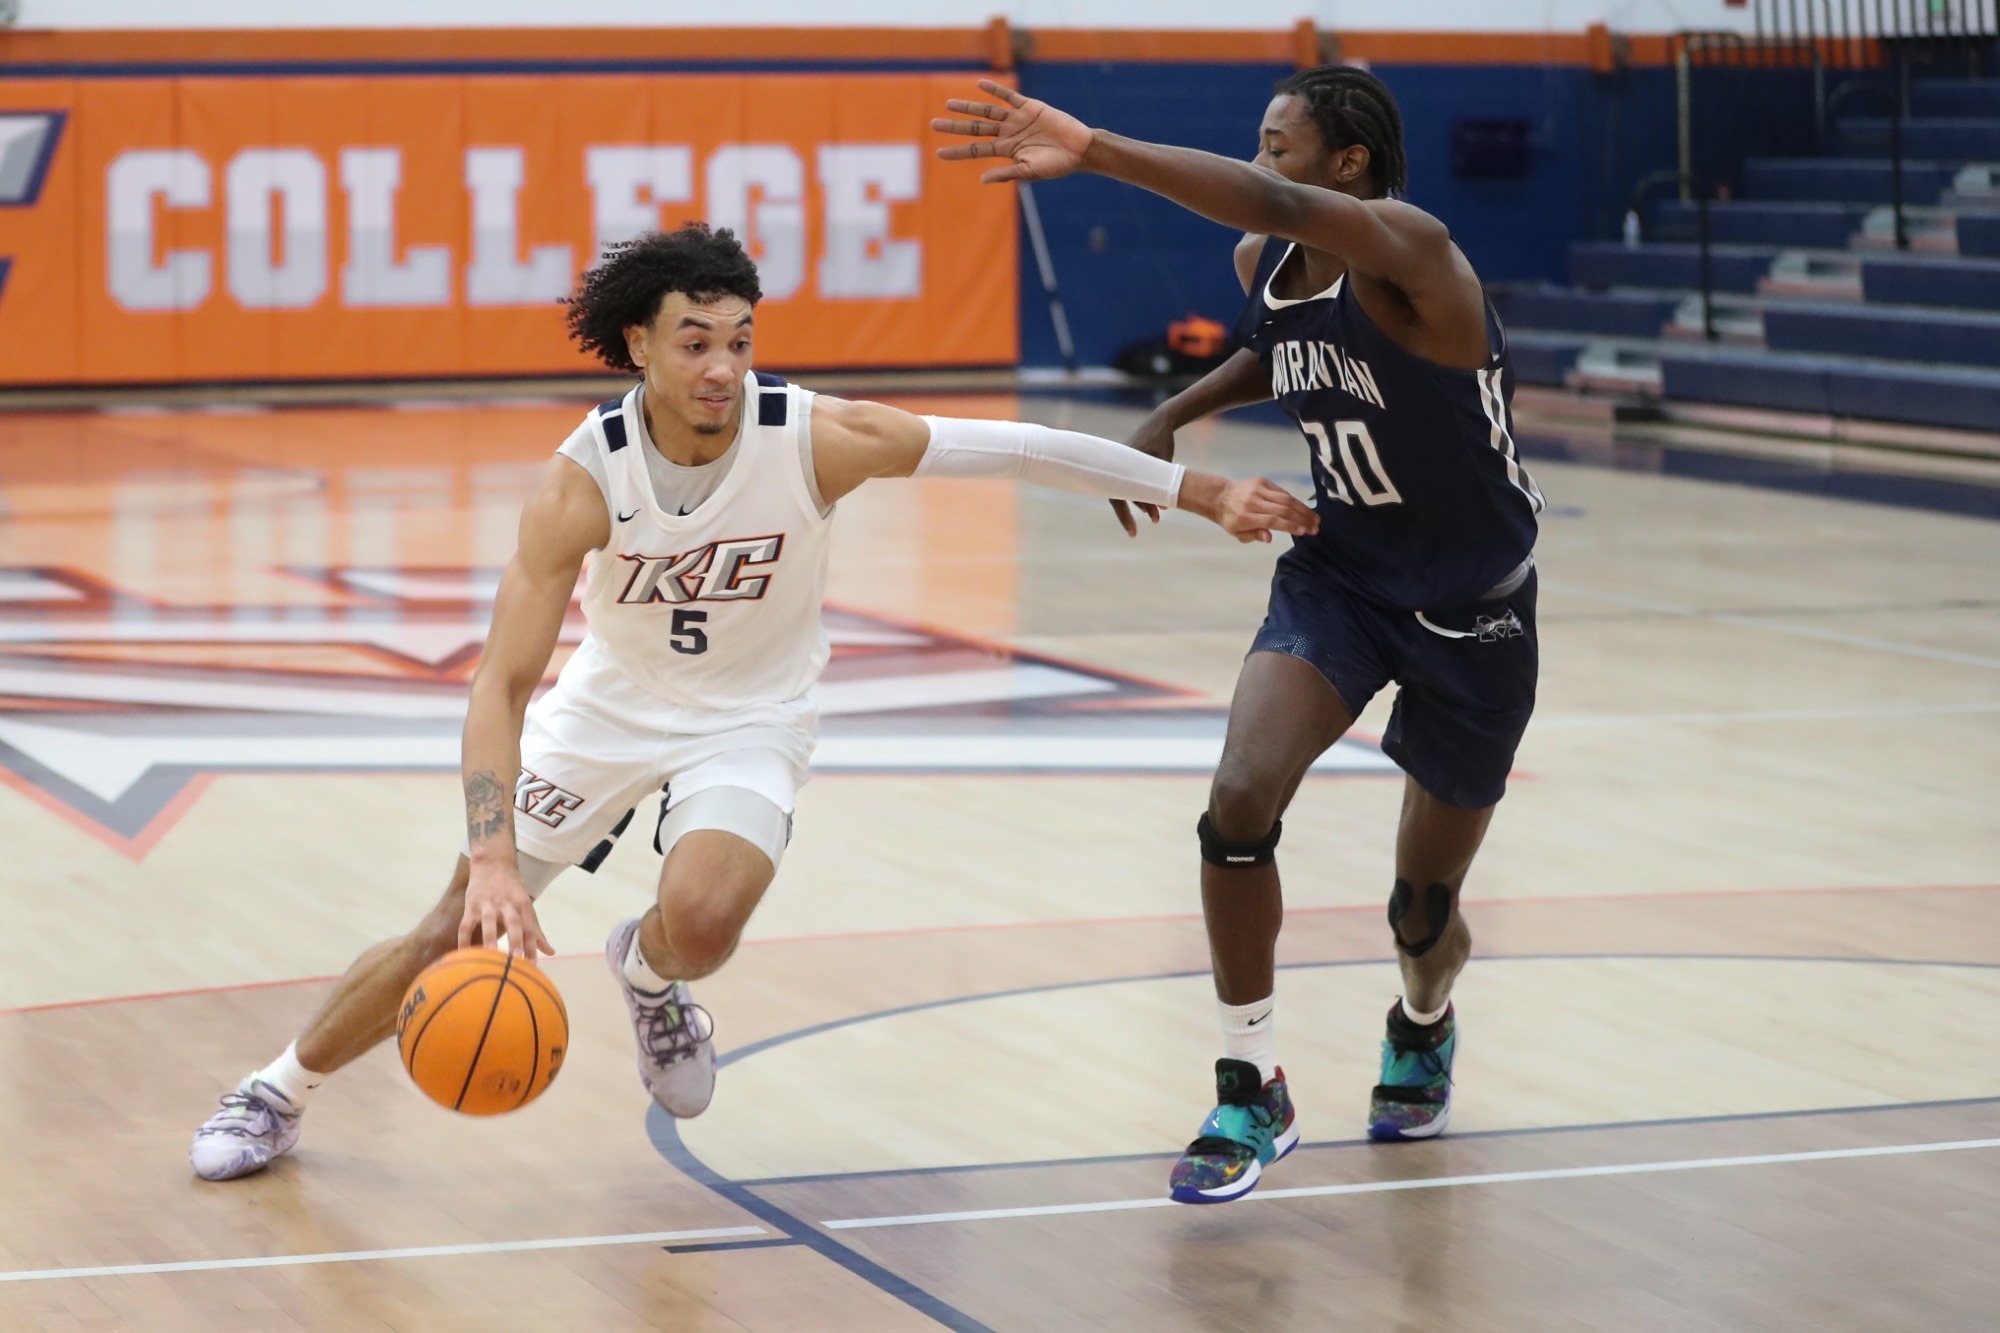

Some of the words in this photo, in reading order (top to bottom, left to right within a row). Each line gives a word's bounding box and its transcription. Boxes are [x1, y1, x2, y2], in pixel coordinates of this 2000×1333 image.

[1300, 419, 1403, 506] 30
[616, 532, 786, 604] KC
[669, 608, 708, 655] 5
